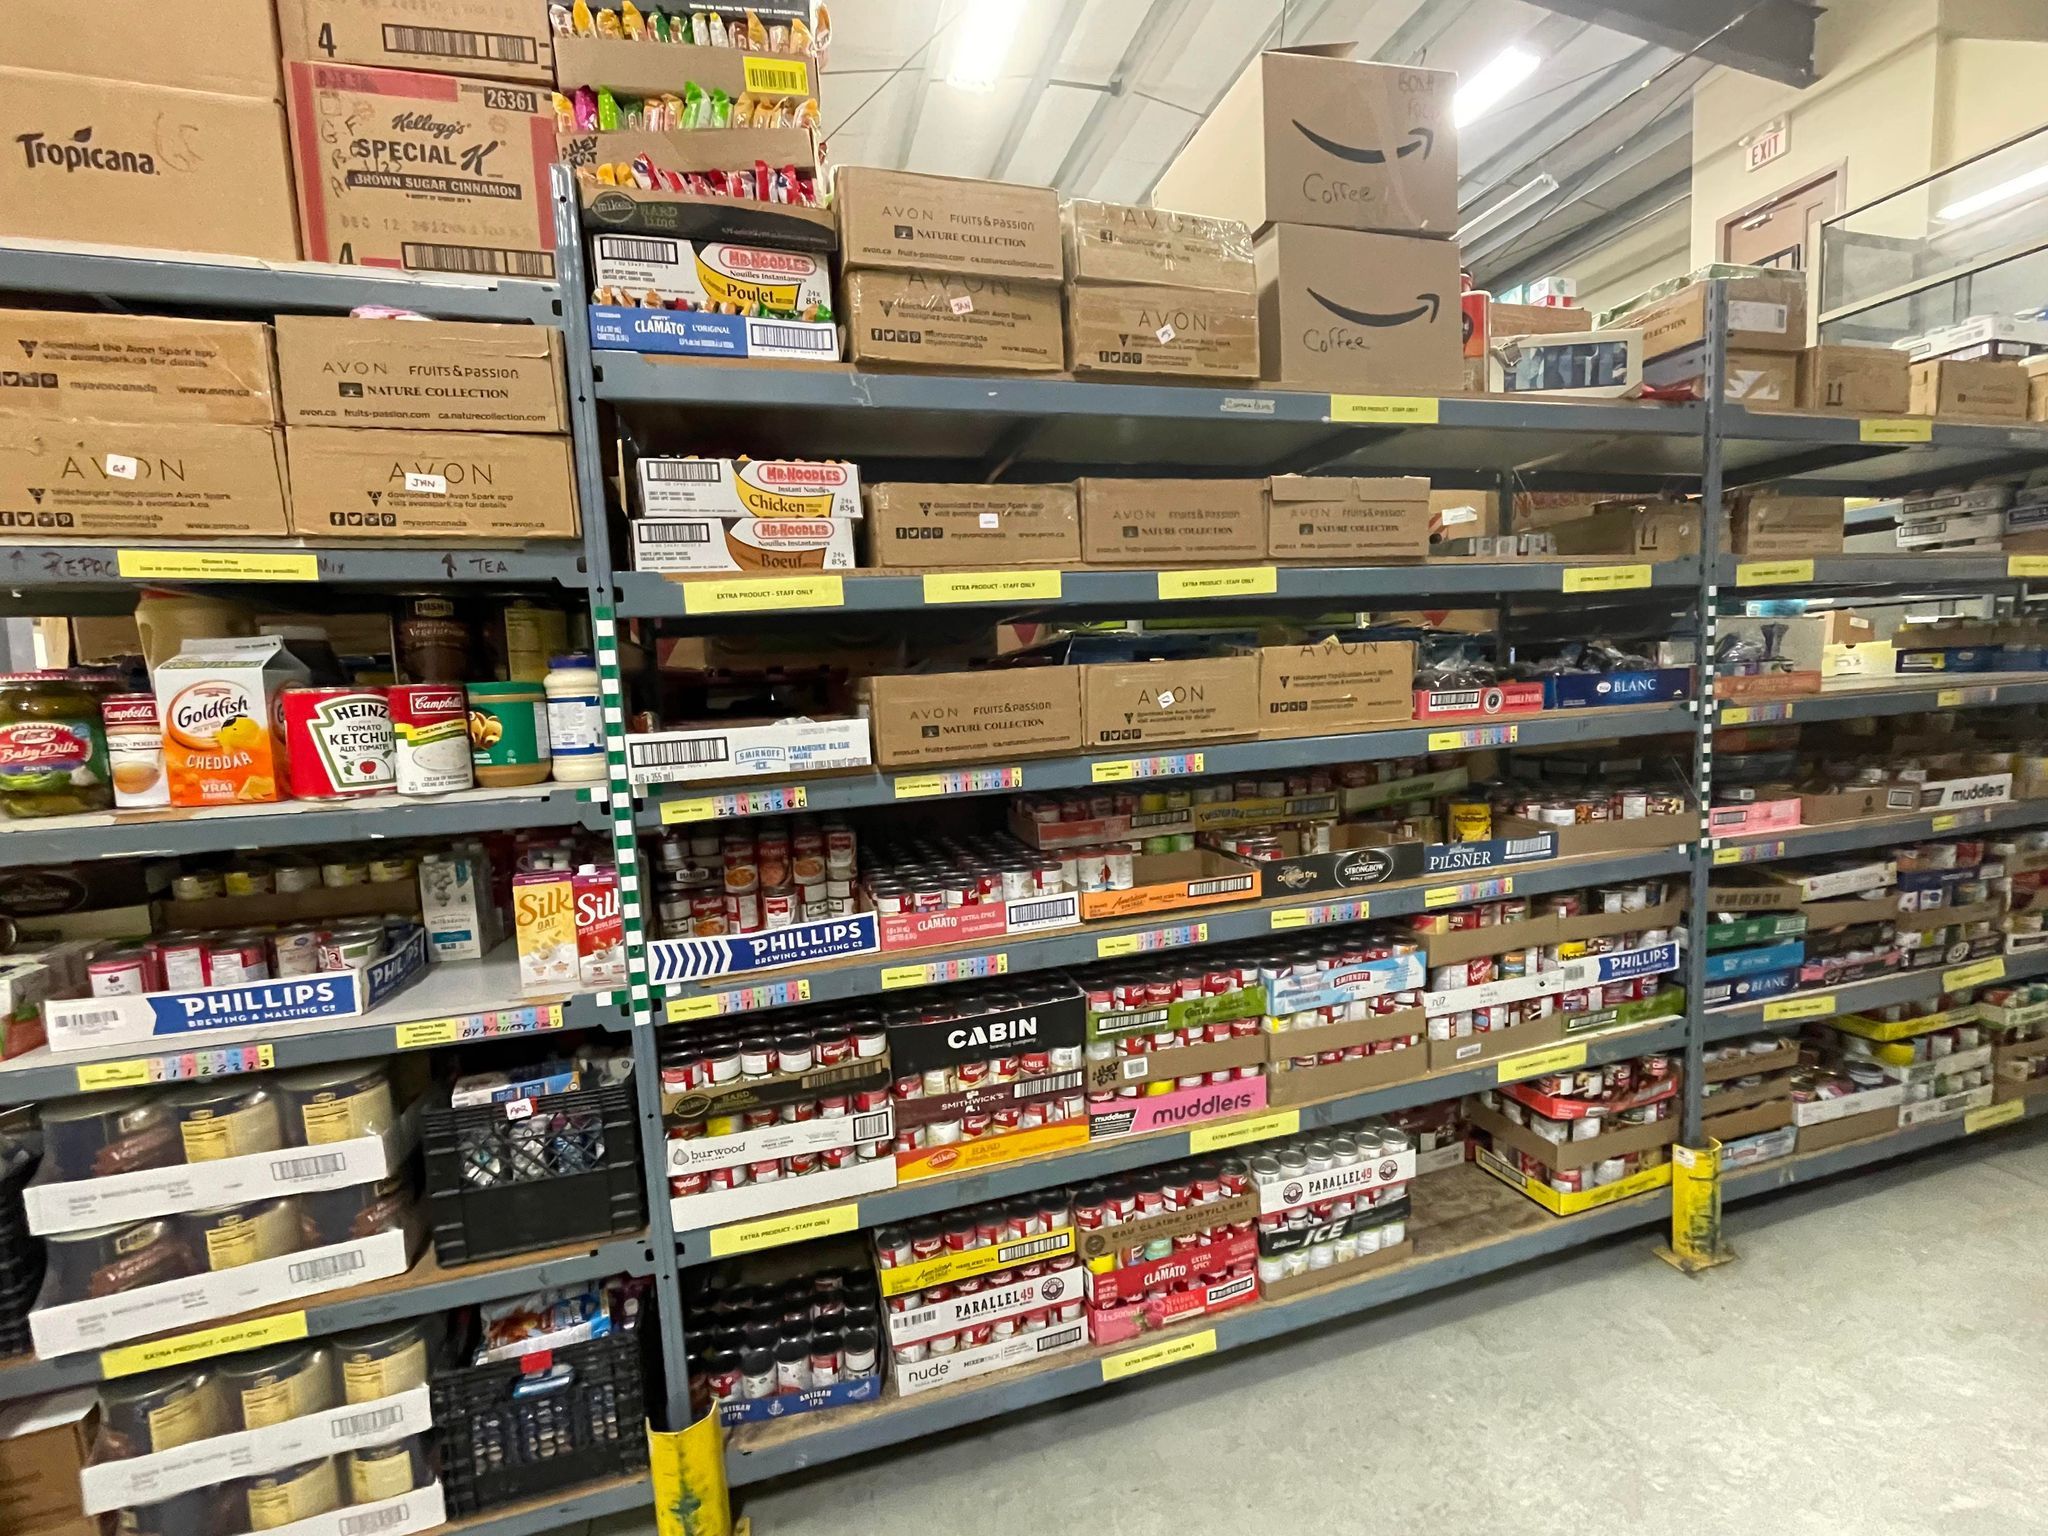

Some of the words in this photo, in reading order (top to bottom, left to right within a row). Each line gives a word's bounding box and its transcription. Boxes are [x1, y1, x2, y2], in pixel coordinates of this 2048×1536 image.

[318, 23, 337, 58] 4
[487, 89, 535, 111] 26361
[391, 111, 465, 139] Kellogg's
[16, 130, 159, 175] Tropicana
[357, 138, 457, 166] SPECIAL
[460, 140, 498, 176] K
[1752, 133, 1779, 166] EXIT
[354, 172, 401, 188] BROWN
[405, 179, 447, 191] SUGAR
[451, 181, 517, 198] CINNAMON
[1303, 173, 1376, 203] Coffee
[881, 205, 934, 222] AVON
[917, 229, 959, 242] NATURE
[961, 233, 1026, 248] COLLECTION
[727, 283, 775, 304] Poulet
[634, 319, 685, 336] CLAMATO
[692, 324, 731, 334] L'ORIGINAL
[1303, 328, 1371, 352] Coffee
[322, 361, 389, 375] AVON
[367, 385, 422, 398] NATURE
[425, 386, 509, 400] COLLECTION
[299, 408, 337, 417] avon.ca
[344, 409, 430, 420] fruits-passion.com
[438, 411, 546, 423] ca.naturecollection.com
[749, 494, 805, 513] Chicken
[839, 504, 855, 513] 85g
[403, 519, 467, 528] myavoncanada
[491, 520, 545, 529] www.avon.ca
[1113, 510, 1156, 520] AVON
[1141, 526, 1176, 536] NATURE
[1178, 525, 1233, 536] COLLECTION
[1316, 524, 1348, 533] NATURE
[1350, 523, 1399, 533] COLLECTION
[469, 557, 508, 574] TEA
[832, 558, 847, 566] 85g
[716, 592, 738, 600] EXTRA
[740, 591, 770, 599] PRODUCT
[1613, 678, 1657, 694] BLANC
[178, 695, 249, 728] Goldfish
[333, 703, 388, 721] HEINZ
[910, 707, 959, 721] AVON
[346, 724, 382, 732] TOMATO
[942, 723, 981, 735] NATURE
[984, 718, 1045, 731] COLLECTION
[40, 742, 79, 756] Dills
[739, 749, 781, 760] SMIRNOFF
[788, 742, 827, 755] FRAMBOISE
[186, 751, 253, 771] CHEDDAR
[651, 773, 663, 783] 355
[200, 783, 234, 792] VRAI
[1952, 782, 2004, 802] muddlers
[718, 808, 727, 816] 2
[728, 806, 737, 816] 2
[739, 803, 748, 814] 4
[752, 802, 760, 811] 4
[775, 800, 783, 810] 5
[1344, 863, 1384, 876] STRONGBOW
[1429, 851, 1491, 871] PILSNER
[516, 887, 574, 927] Silk
[537, 918, 555, 930] OAT
[917, 916, 959, 932] CLAMATO
[961, 914, 980, 923] EXTRA
[751, 921, 862, 956] PHILLIPS
[754, 951, 798, 965] BREWING
[800, 950, 807, 958] &
[809, 943, 850, 956] MALTING
[1608, 950, 1669, 971] PHILLIPS
[1335, 972, 1370, 987] SMIRNOFF
[1750, 975, 1790, 992] BLANC
[177, 981, 335, 1018] PHILLIPS
[801, 990, 809, 998] 2
[186, 1012, 248, 1029] BREWING
[251, 1012, 260, 1021] &
[264, 1006, 318, 1021] MALTING
[462, 1028, 480, 1038] BY
[947, 1016, 1037, 1049] CABIN
[201, 1065, 211, 1074] 2
[217, 1063, 227, 1073] 2
[232, 1062, 242, 1072] 2
[260, 1058, 270, 1067] 3
[941, 1093, 1005, 1111] SMITHWICK'S
[1153, 1095, 1251, 1125] muddlers
[1094, 1111, 1132, 1123] muddlers
[690, 1141, 747, 1161] burwood
[1308, 1170, 1362, 1193] PARALLEL
[1361, 1167, 1373, 1180] 49
[1112, 1227, 1136, 1240] EAU
[1137, 1216, 1182, 1234] CLAIRE
[1186, 1200, 1250, 1222] DISTILLERY
[740, 1233, 761, 1242] EXTRA
[761, 1226, 790, 1237] PRODUCT
[795, 1222, 813, 1231] STAFF
[814, 1218, 830, 1227] ONLY
[1303, 1220, 1347, 1247] ICE
[1190, 1253, 1211, 1265] EXTRA
[1143, 1264, 1188, 1287] CLAMATO
[955, 1290, 1021, 1318] PARALLEL
[1020, 1286, 1034, 1301] 49
[145, 1346, 171, 1361] EXTRA
[173, 1338, 214, 1356] PRODUCT
[220, 1333, 244, 1347] STAFF
[245, 1327, 270, 1342] ONLY
[909, 1362, 950, 1383] nude
[800, 1389, 832, 1402] ARTISAN
[809, 1398, 824, 1407] IPA
[727, 1412, 743, 1422] IPA
